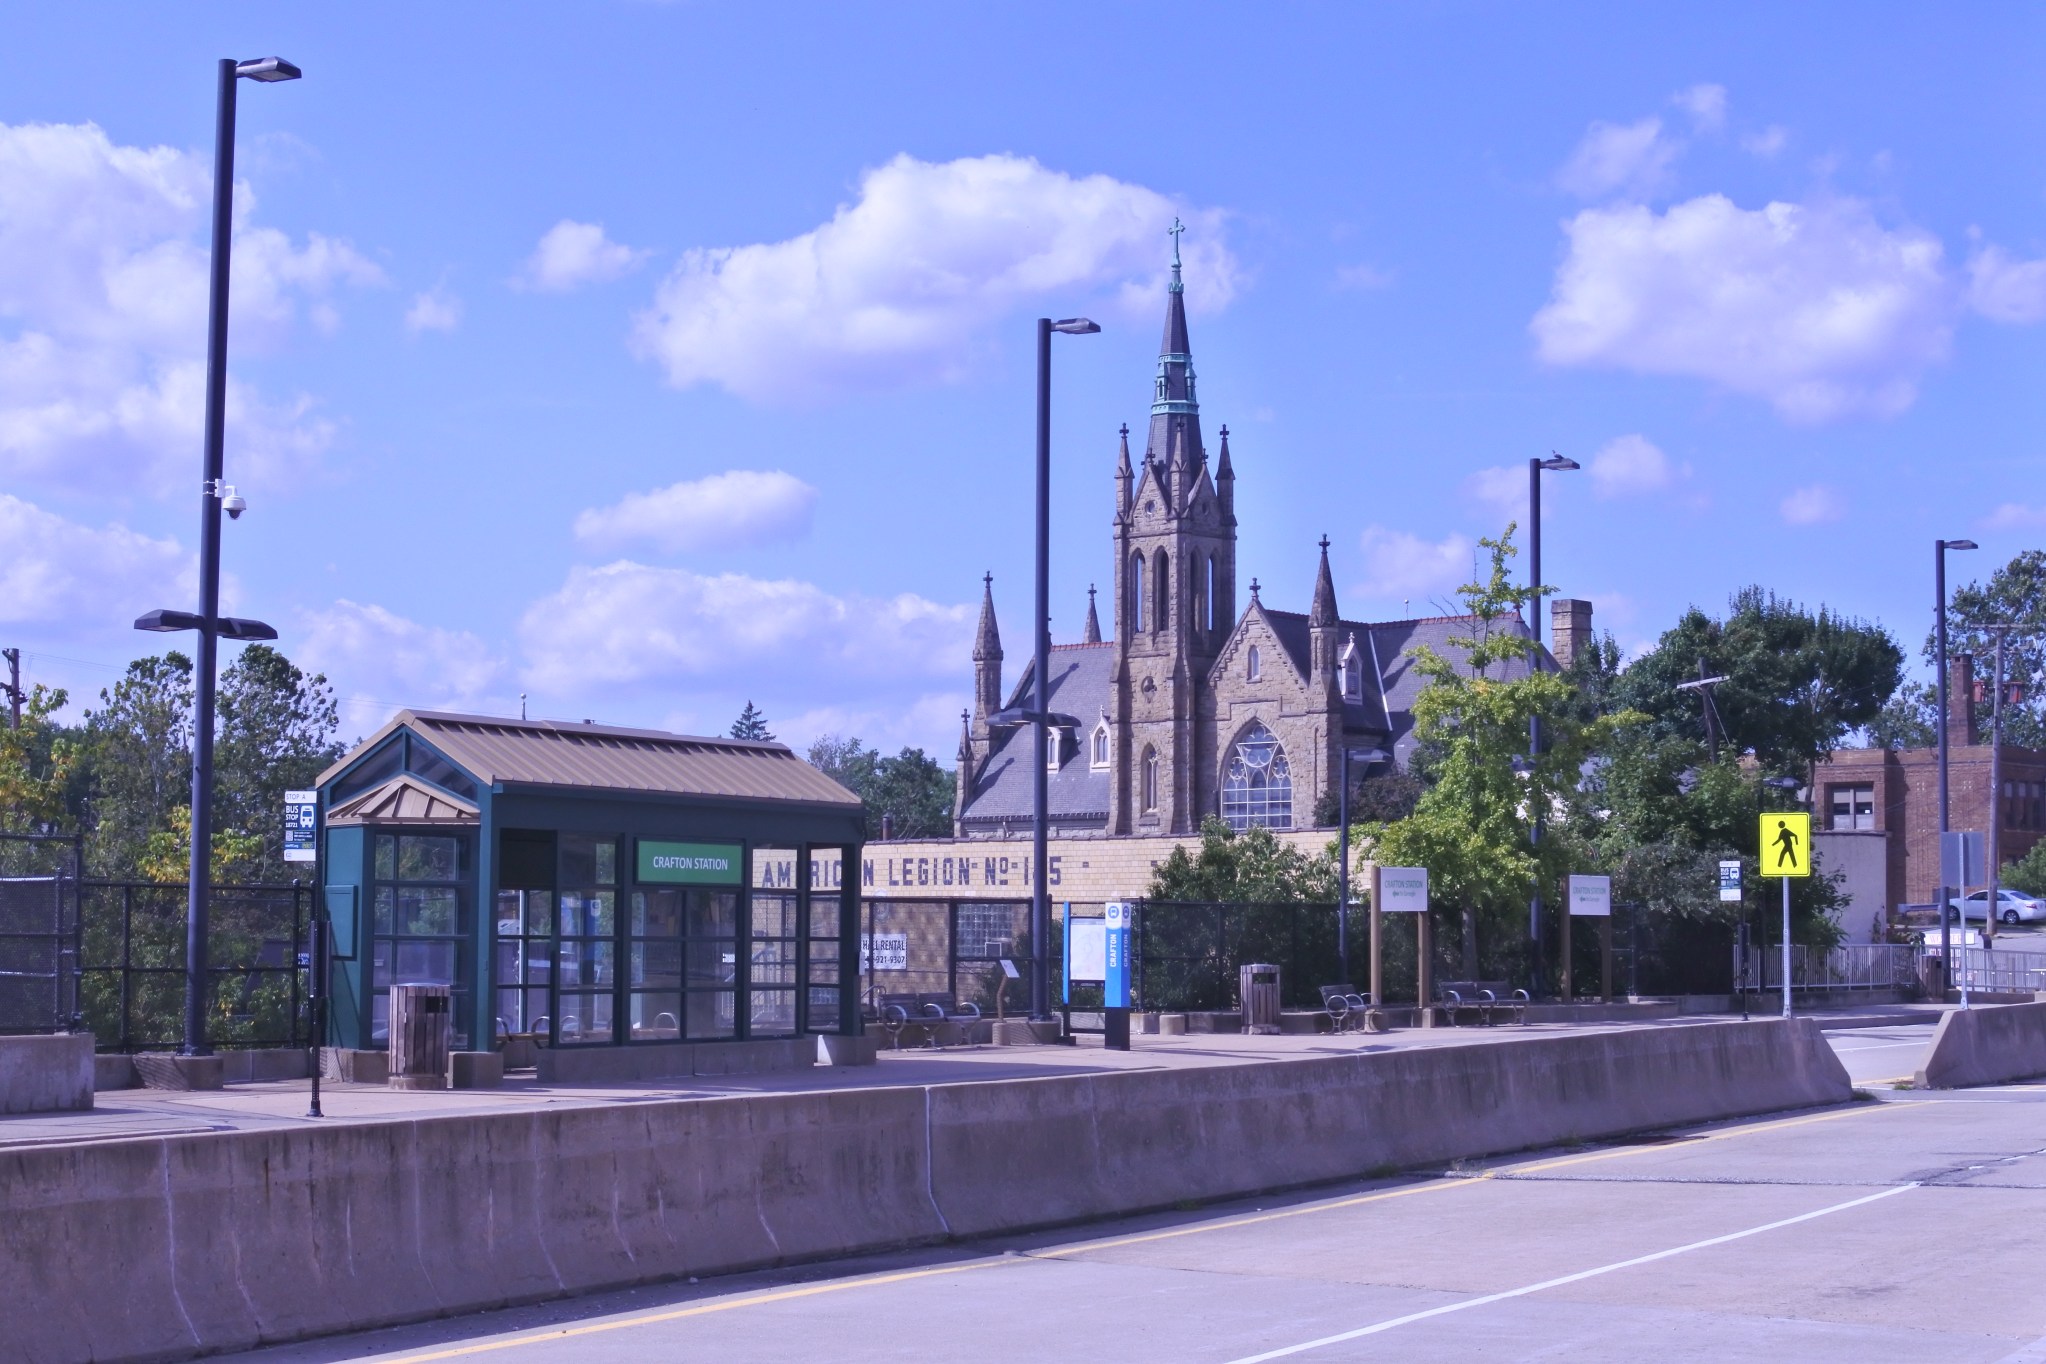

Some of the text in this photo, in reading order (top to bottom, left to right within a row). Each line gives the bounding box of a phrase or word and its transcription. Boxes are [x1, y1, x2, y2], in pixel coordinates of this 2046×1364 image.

[286, 805, 299, 814] BUS
[286, 813, 299, 821] STOP
[653, 856, 728, 871] CRAFTON STATION
[762, 858, 874, 888] AMRICN
[1024, 856, 1062, 886] 15
[1384, 880, 1423, 889] CRAFTON STATION
[880, 940, 905, 951] RENTAL
